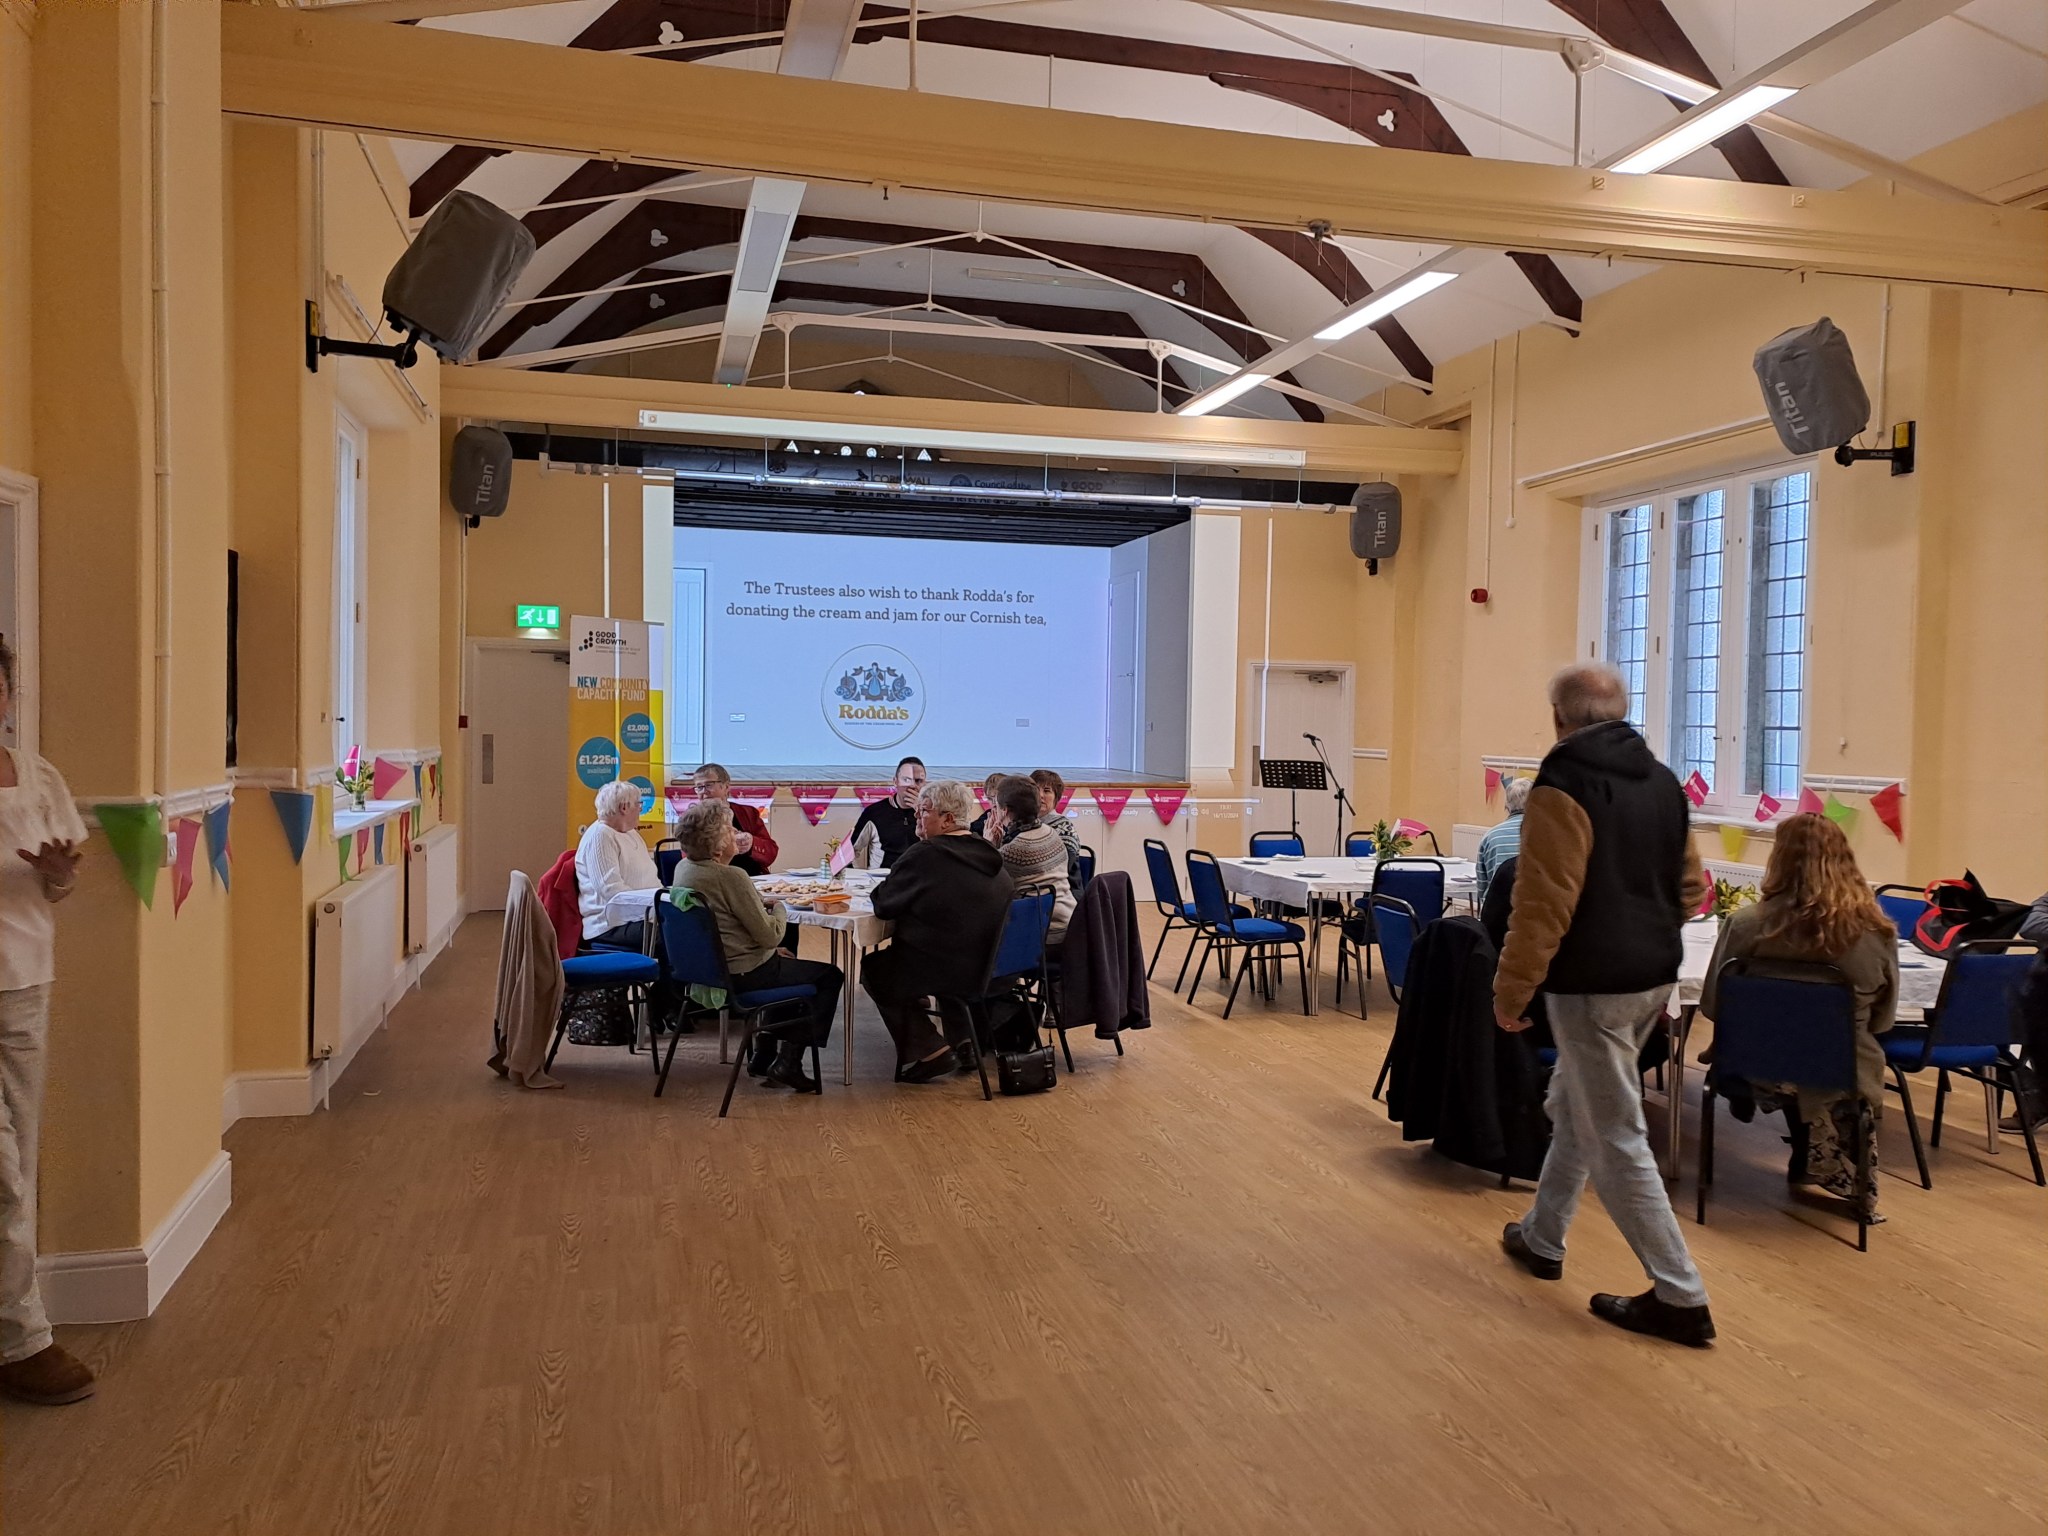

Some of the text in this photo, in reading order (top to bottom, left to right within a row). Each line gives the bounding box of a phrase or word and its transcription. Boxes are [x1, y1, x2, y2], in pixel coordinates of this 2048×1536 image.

[1774, 381, 1810, 439] Titan
[476, 463, 495, 505] Titan
[1071, 481, 1103, 491] GOOD
[1374, 511, 1387, 549] Titan
[744, 581, 1035, 604] The Trustees also wish to thank Rodda's for
[726, 603, 1047, 626] donating the cream and jam for our Cornish tea,
[595, 630, 617, 639] GOOD
[595, 637, 627, 646] GROWTH
[577, 676, 598, 688] NEW
[621, 690, 646, 701] FUND
[839, 704, 910, 720] Rodda's
[627, 724, 650, 732] £2,000
[579, 754, 619, 765] £1.225m
